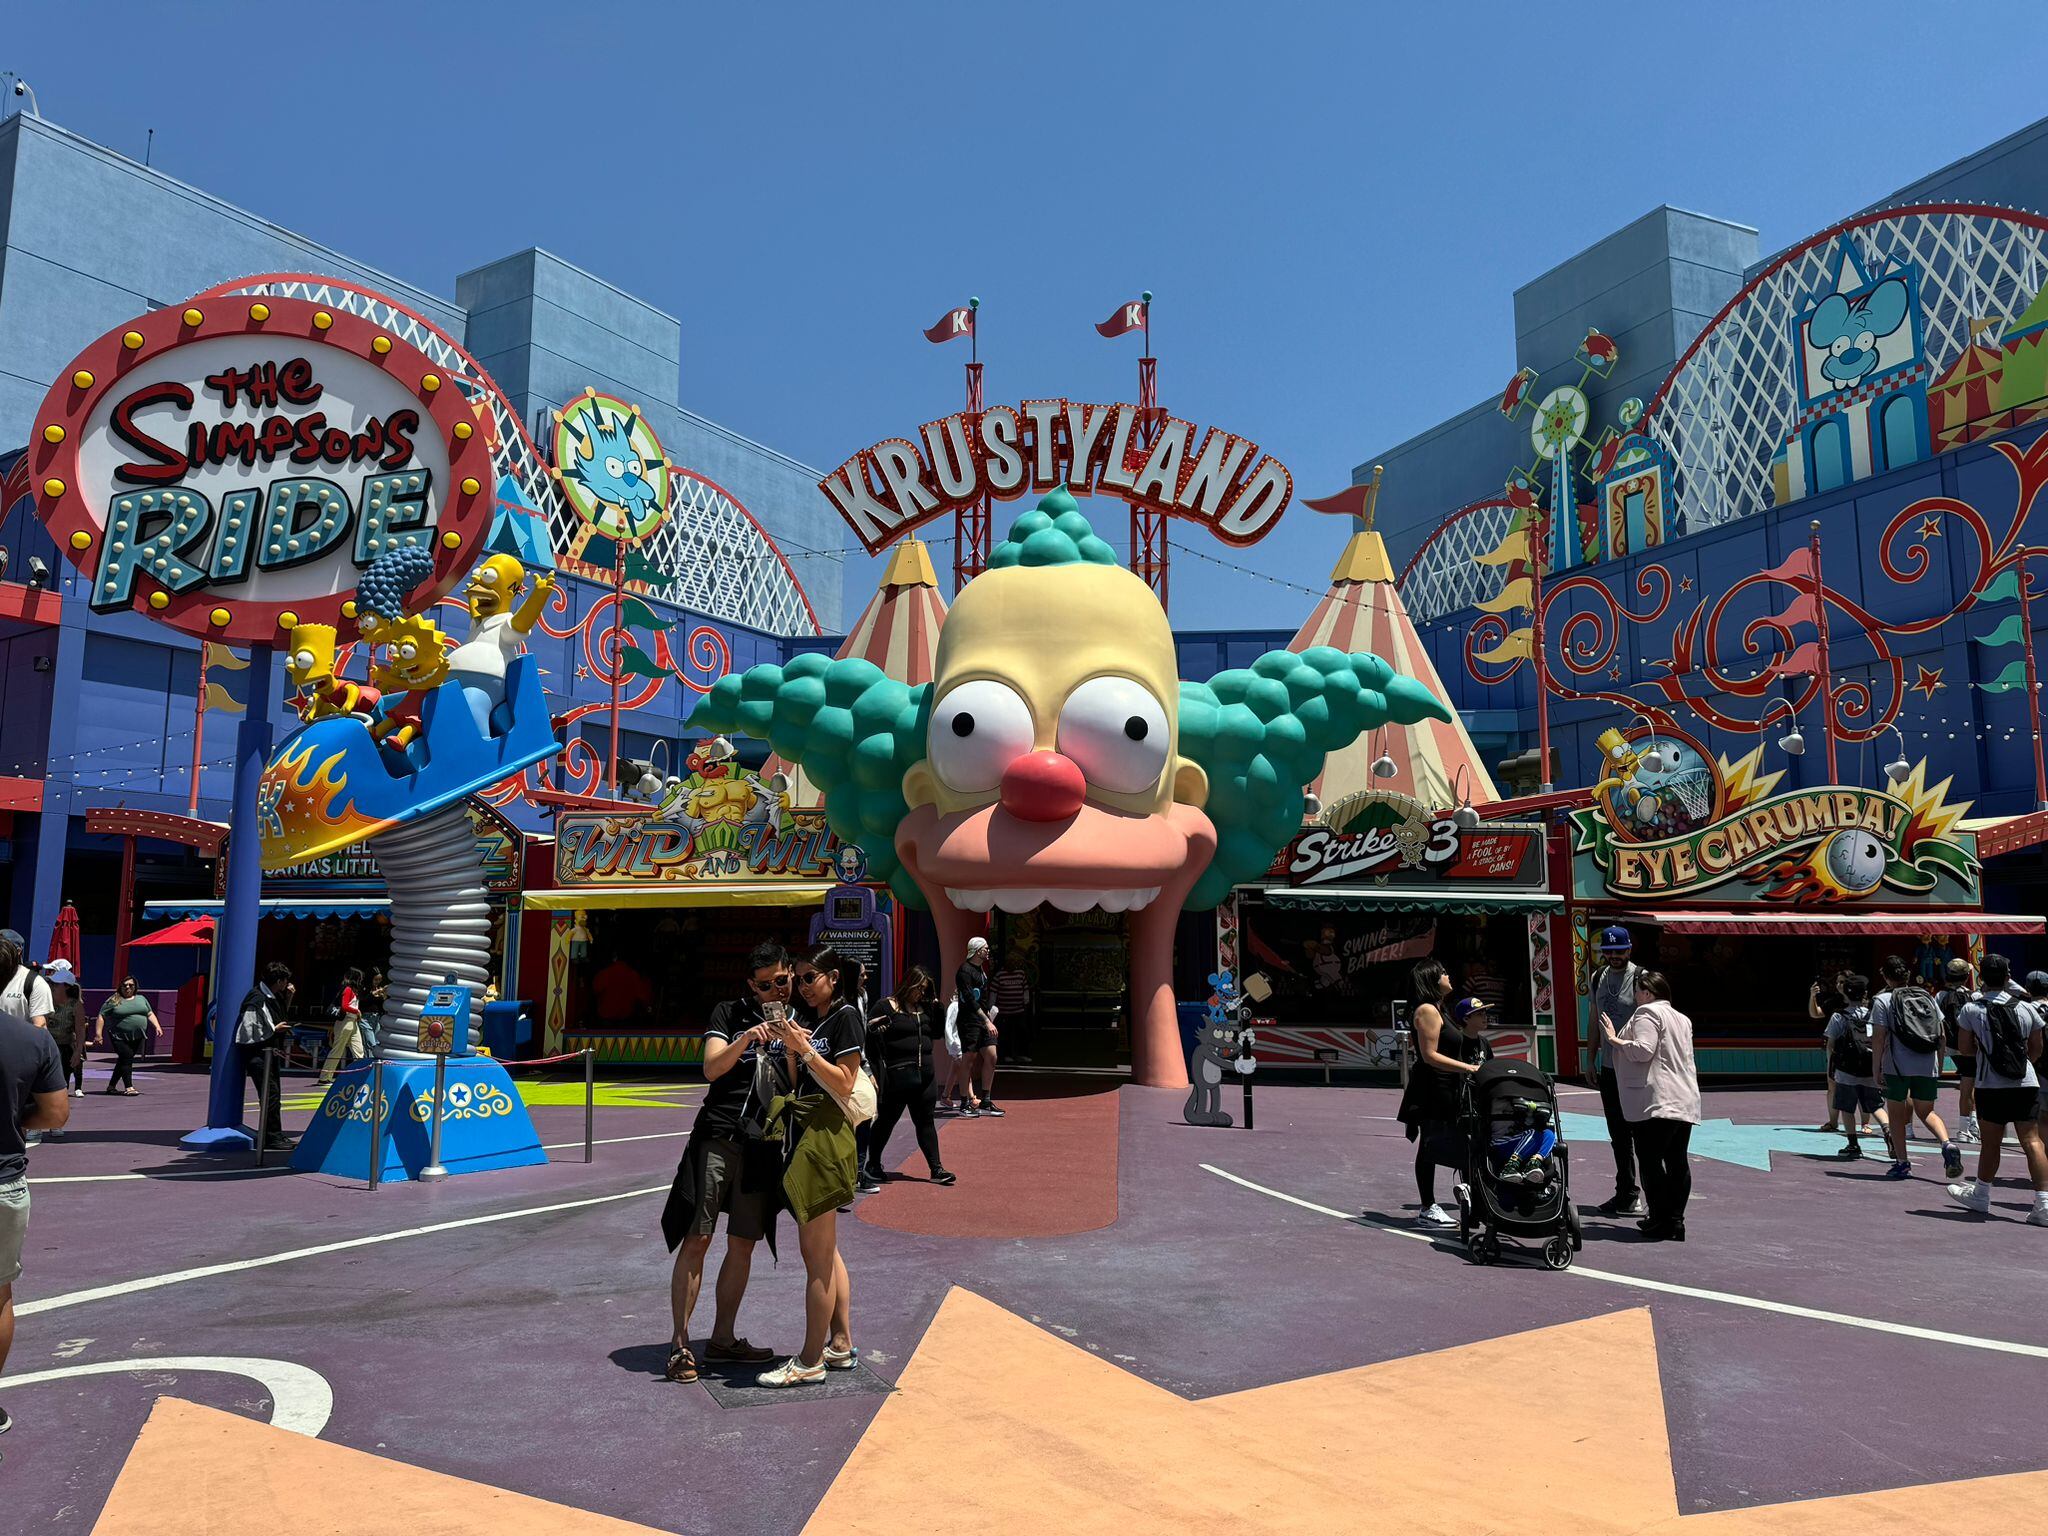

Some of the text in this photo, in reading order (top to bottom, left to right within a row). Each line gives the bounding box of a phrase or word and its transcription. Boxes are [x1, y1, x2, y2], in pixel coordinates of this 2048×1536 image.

[952, 310, 967, 333] K
[1126, 304, 1141, 327] K
[205, 357, 324, 408] THE
[817, 398, 1294, 557] KRUSTYLAND
[90, 468, 438, 614] RIDE
[257, 779, 286, 840] K
[700, 854, 740, 877] AND
[738, 822, 841, 877] WILL
[1290, 820, 1459, 873] Strike 3
[1472, 847, 1492, 859] FOOL
[1614, 792, 1906, 890] EYE CARUMBA!
[335, 859, 380, 874] LITTL
[1488, 859, 1515, 873] CANS!
[829, 931, 870, 939] WARNING
[1342, 928, 1388, 957] SWING
[1346, 940, 1405, 974] BATTER!
